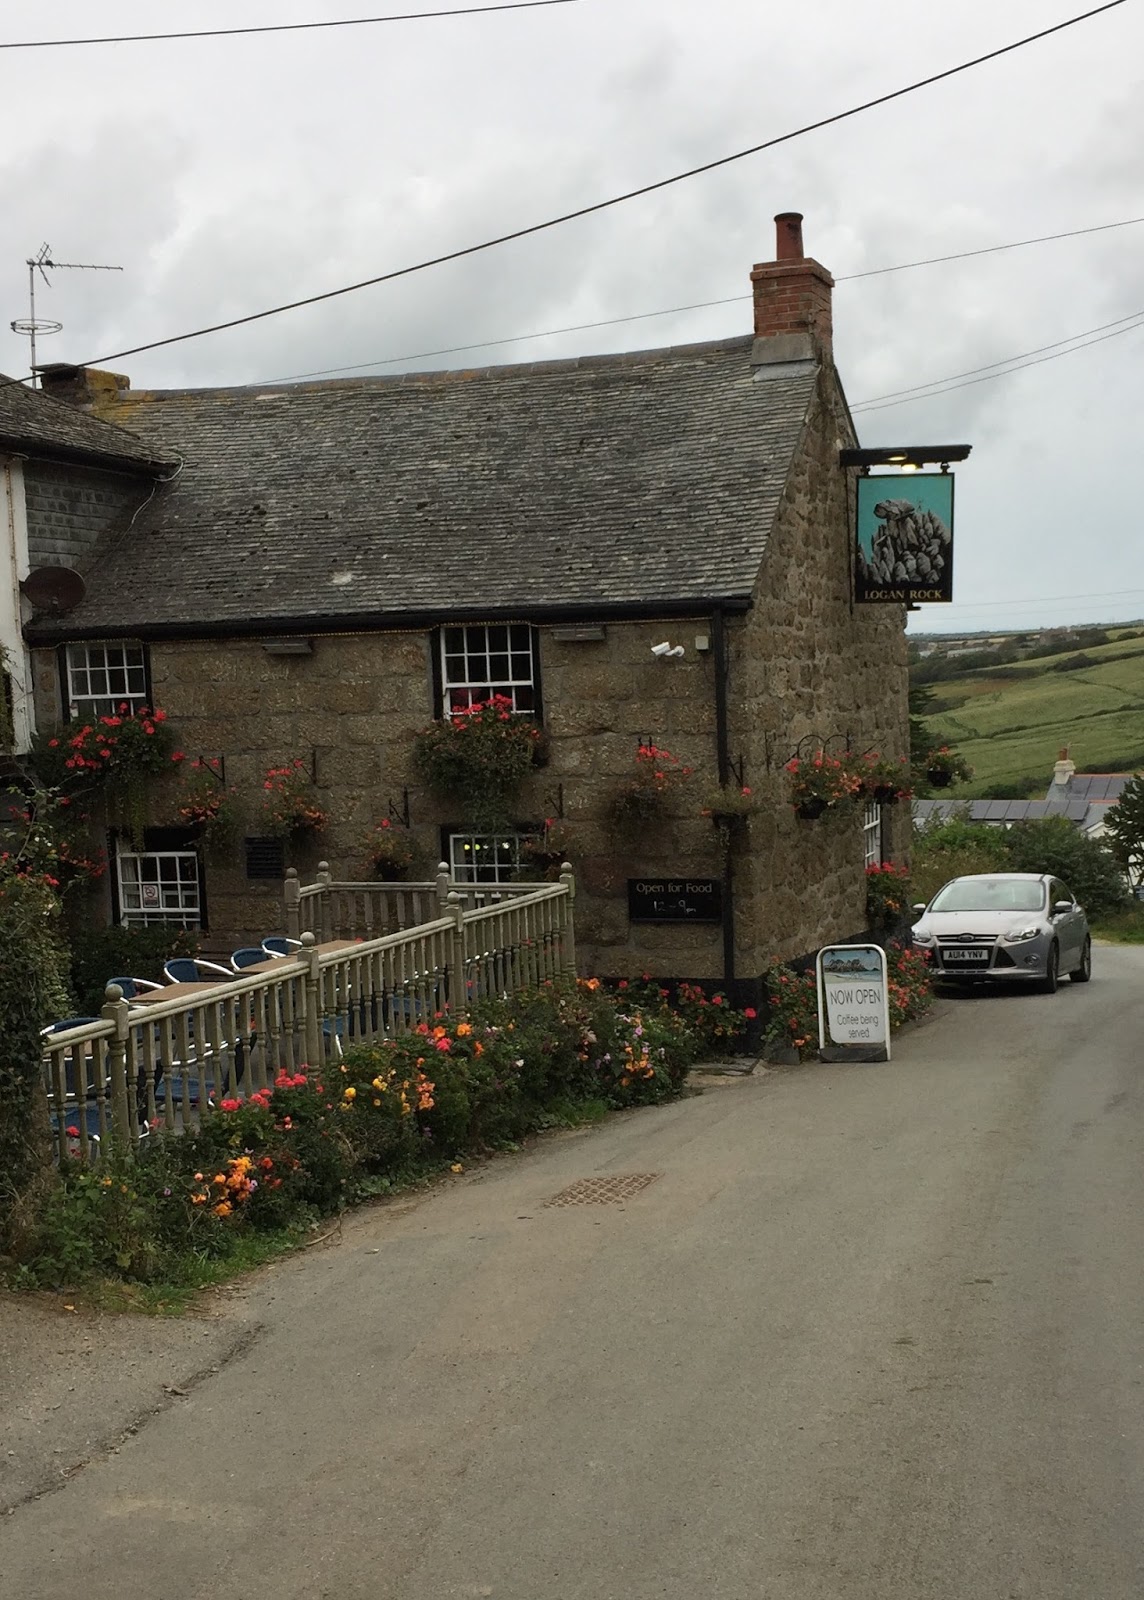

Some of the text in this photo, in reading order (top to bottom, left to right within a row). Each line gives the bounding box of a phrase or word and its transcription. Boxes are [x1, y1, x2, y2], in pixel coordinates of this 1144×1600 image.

[864, 590, 942, 599] LOGAN ROCK
[636, 882, 713, 895] Open for Food
[830, 989, 880, 1005] NOW OPEN
[837, 1014, 878, 1027] Coffee being
[848, 1028, 870, 1038] served
